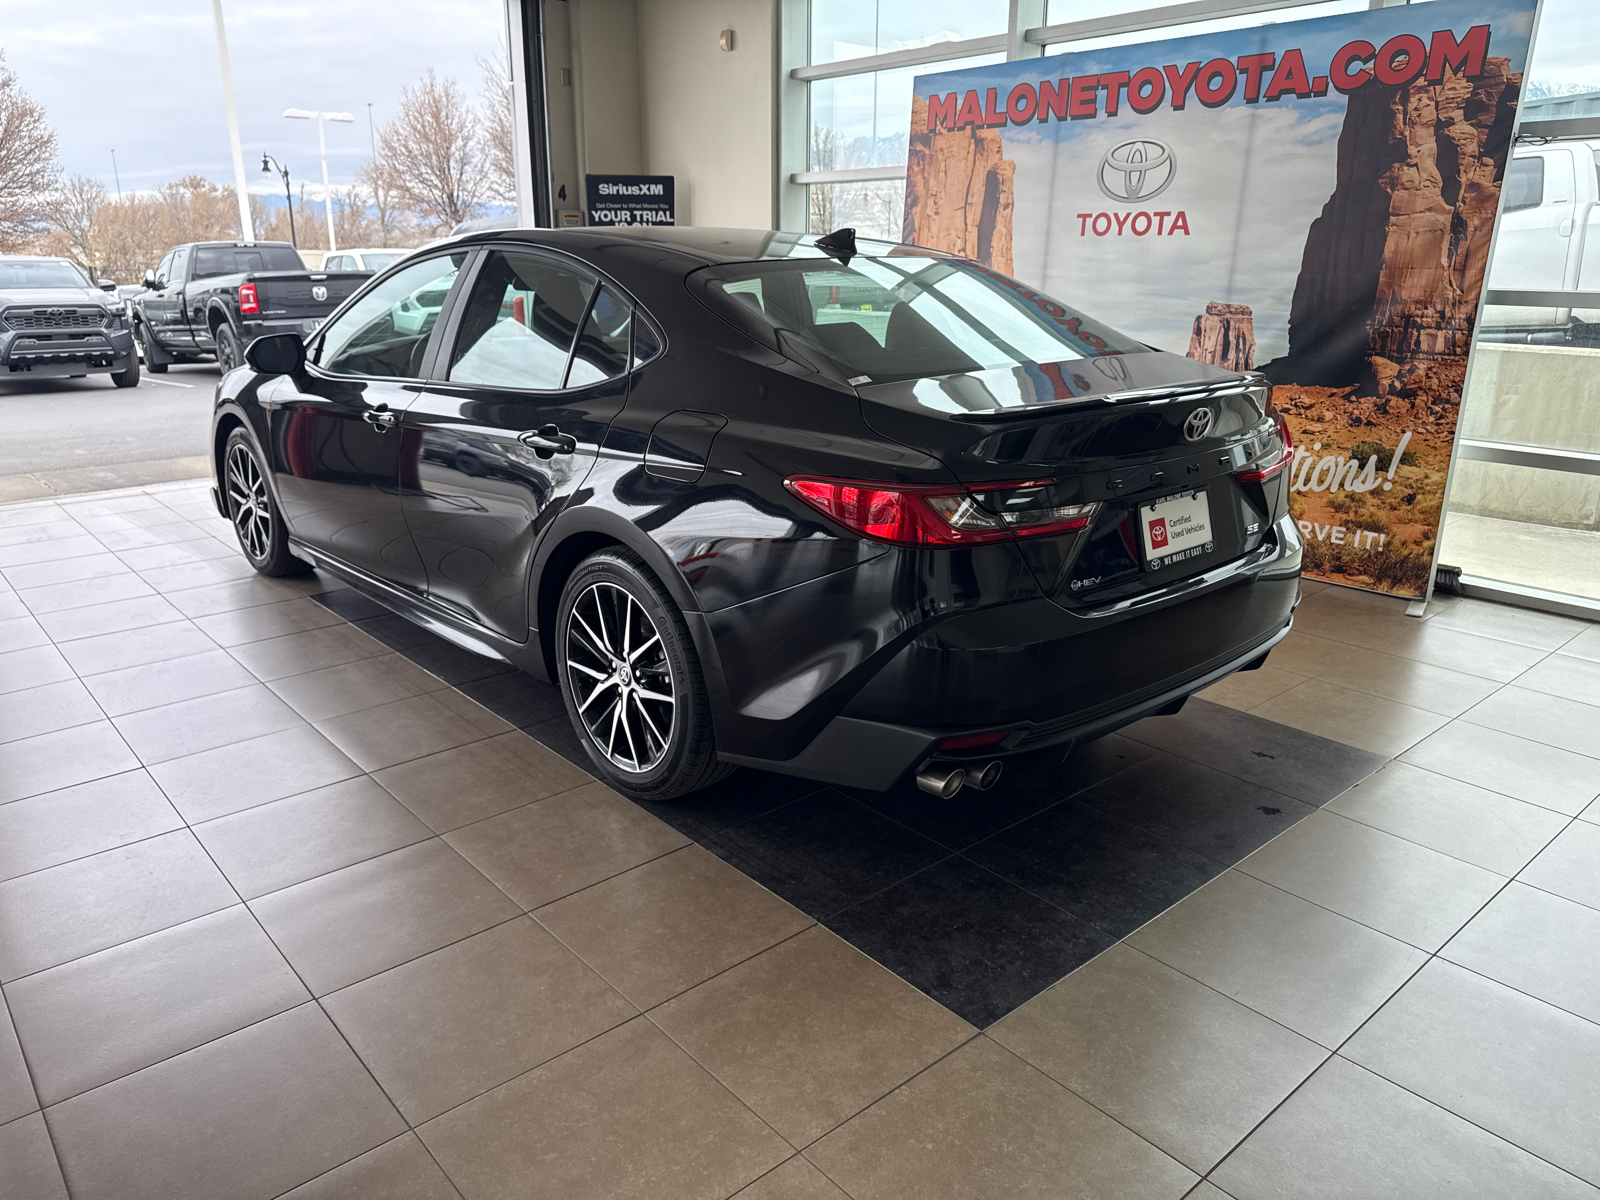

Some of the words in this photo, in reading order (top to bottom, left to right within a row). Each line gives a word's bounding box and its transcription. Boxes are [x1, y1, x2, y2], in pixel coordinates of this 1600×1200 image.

[927, 24, 1492, 133] MALONETOYOTA.COM
[558, 184, 567, 202] 4
[598, 183, 664, 196] SiriusXM
[591, 210, 631, 222] YOUR
[633, 210, 674, 222] TRIAL
[1077, 211, 1190, 236] TOYOTA
[1169, 514, 1191, 527] Certified
[1246, 522, 1259, 535] SE
[1171, 528, 1185, 539] Used
[1185, 523, 1205, 535] Vehicles
[1353, 530, 1386, 552] IT!
[1163, 556, 1172, 565] WE
[1172, 552, 1185, 563] MAKE
[1185, 550, 1190, 558] IT
[1190, 546, 1202, 557] EASY
[657, 616, 684, 675] Continental
